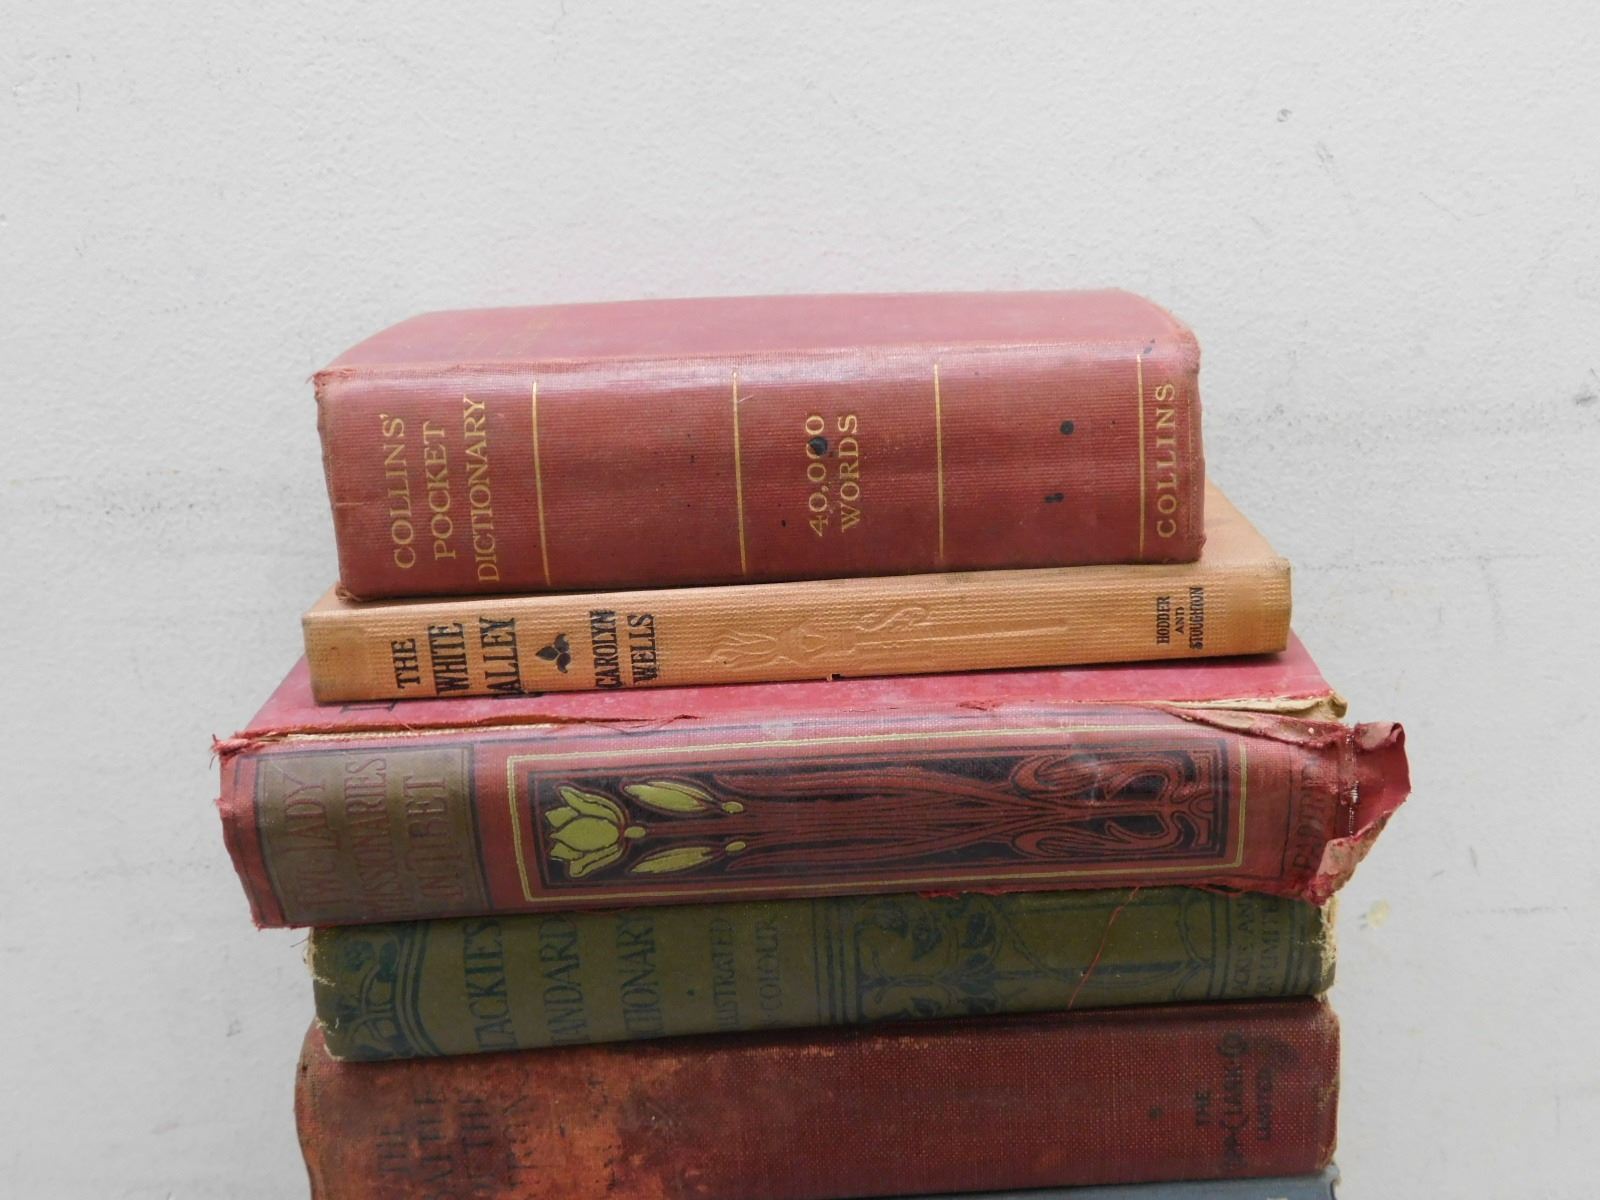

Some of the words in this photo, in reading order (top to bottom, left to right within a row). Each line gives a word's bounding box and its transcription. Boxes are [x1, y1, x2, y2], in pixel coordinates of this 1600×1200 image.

[379, 412, 416, 570] COLLINS'
[422, 420, 456, 561] POCKET
[463, 394, 501, 583] DICTIONARY
[837, 414, 861, 534] WORDS
[1155, 382, 1178, 540] COLLINS
[427, 621, 471, 697] WHITE
[477, 615, 524, 695] ALLEY
[588, 609, 623, 690] CAROLYN
[627, 611, 659, 683] WELLS
[1155, 596, 1171, 645] HODDER
[1174, 606, 1185, 635] AND
[1188, 586, 1205, 650] STOUGHTON
[390, 637, 421, 689] THE
[279, 772, 343, 855] LADY
[401, 774, 464, 872] TIBET
[463, 918, 518, 1053] LACKIE'S
[537, 912, 591, 1046] TANDARD
